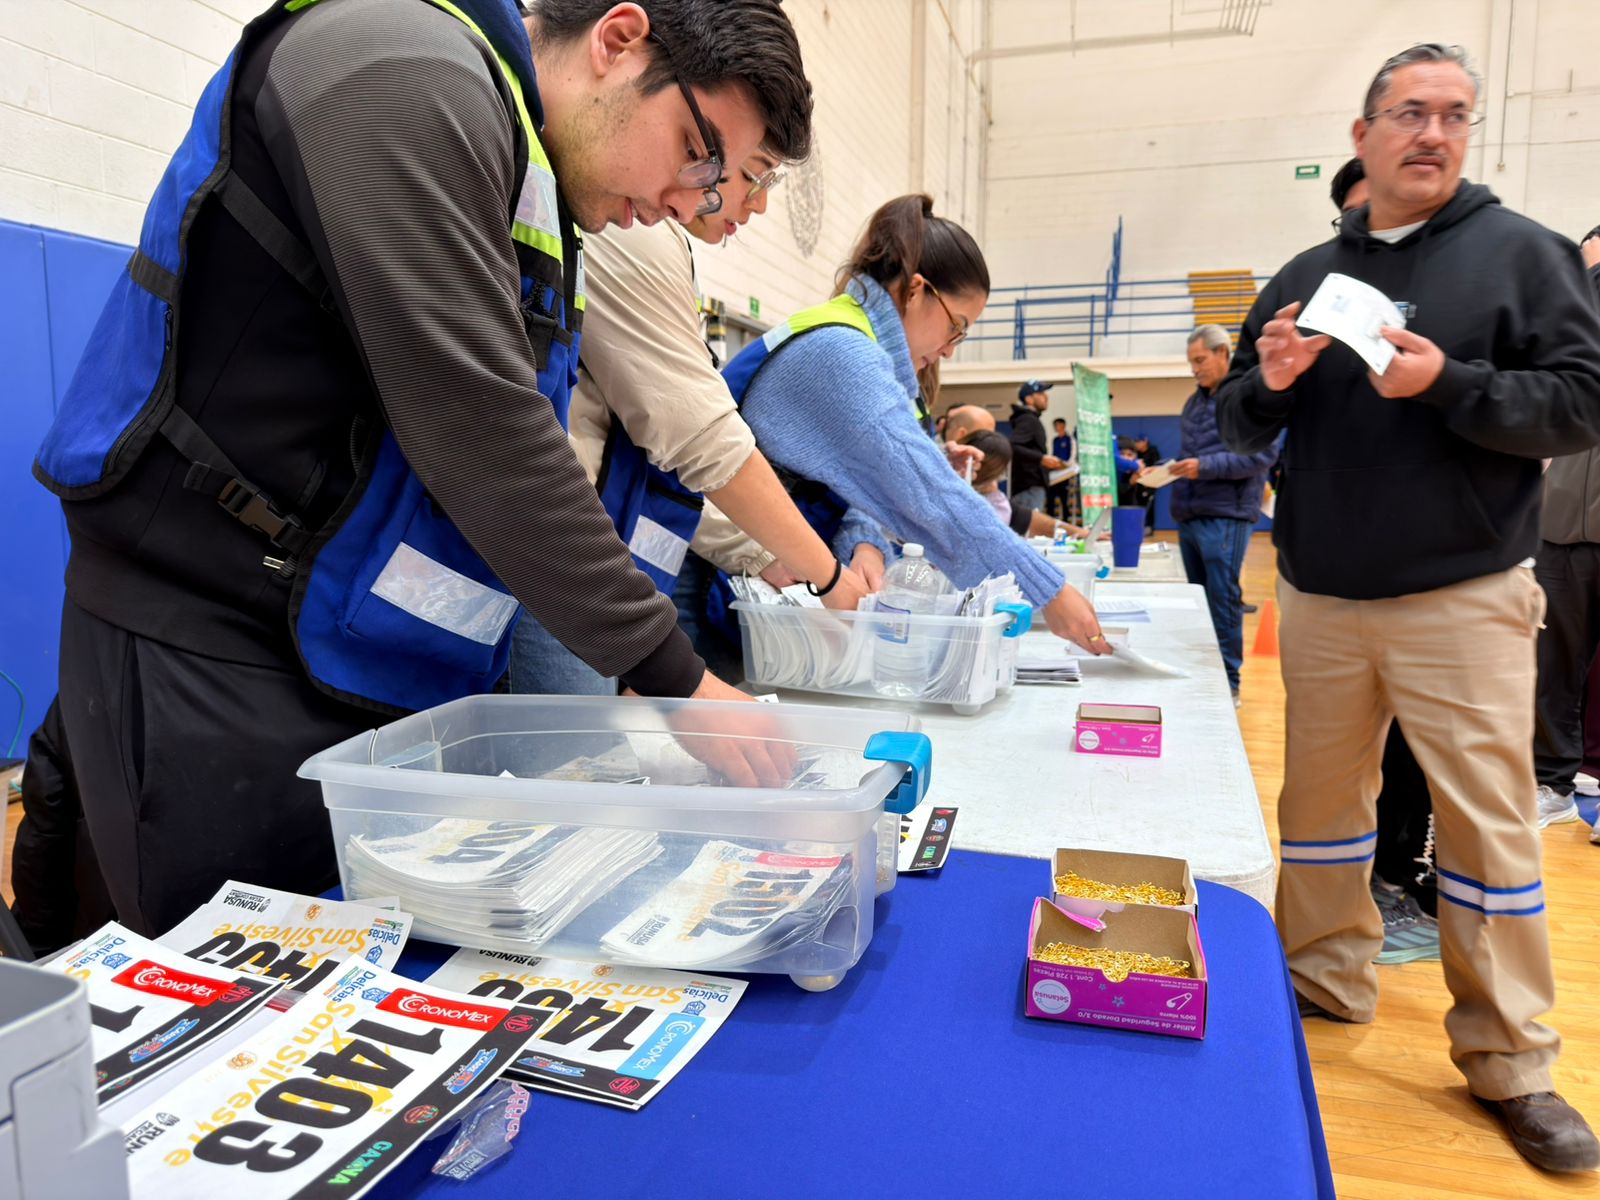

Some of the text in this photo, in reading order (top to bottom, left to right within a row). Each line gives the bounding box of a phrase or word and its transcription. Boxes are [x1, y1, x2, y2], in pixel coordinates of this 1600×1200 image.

[223, 895, 260, 913] RUNUSA
[368, 927, 401, 946] Delicias
[73, 937, 127, 969] Delicias
[478, 949, 531, 966] RUNUSA
[332, 970, 376, 1003] Delicias
[682, 987, 729, 1003] Delicias
[1034, 990, 1070, 1003] Selanusa
[1092, 1012, 1120, 1023] Dorado
[1121, 1015, 1160, 1028] Seguridad
[1160, 1021, 1171, 1029] de
[1172, 1022, 1197, 1032] Alfiler
[193, 1018, 445, 1173] 1403
